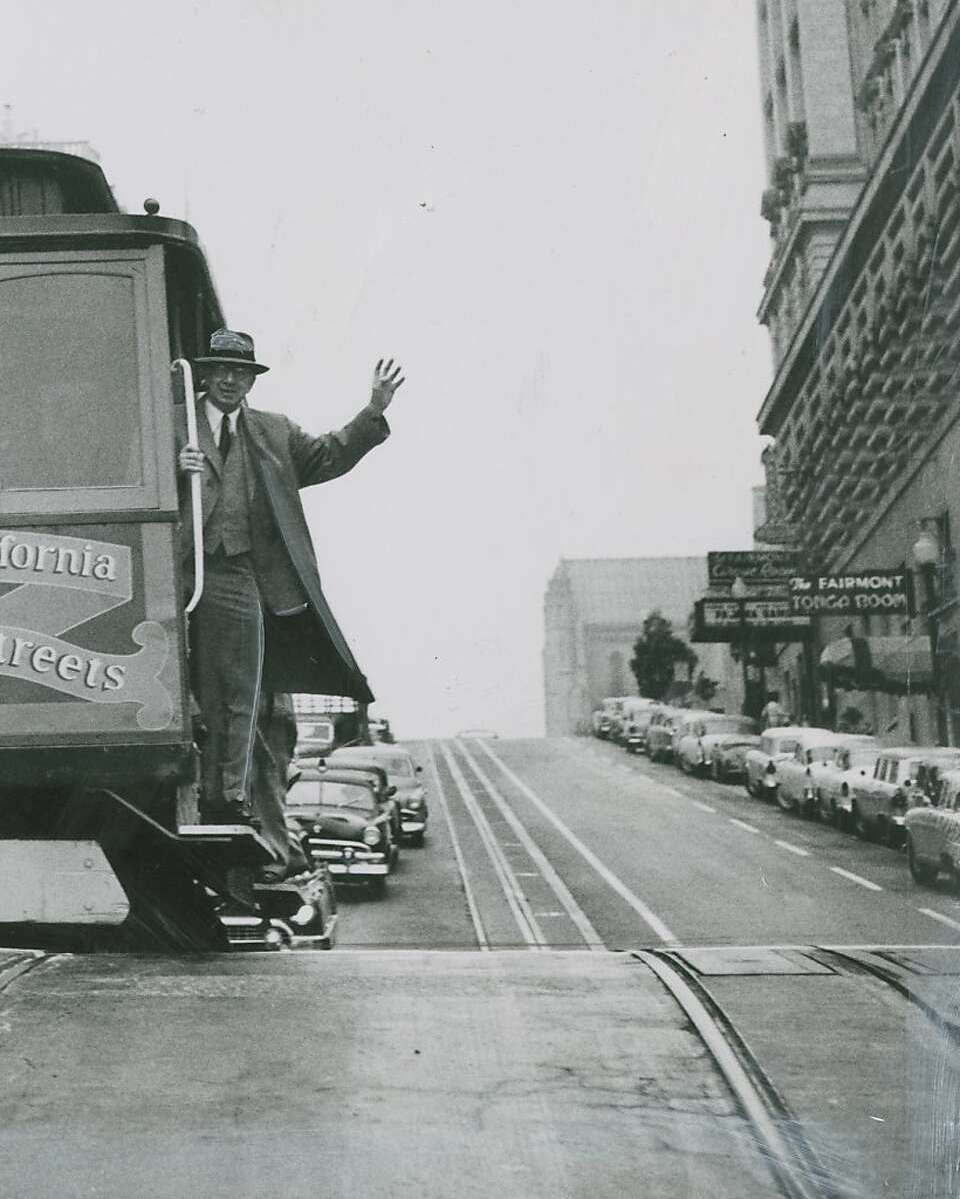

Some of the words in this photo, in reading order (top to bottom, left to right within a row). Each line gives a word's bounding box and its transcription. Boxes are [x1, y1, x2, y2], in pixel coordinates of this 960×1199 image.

[788, 576, 812, 591] The
[818, 575, 904, 589] FAIRMONT
[855, 593, 905, 609] ROOM
